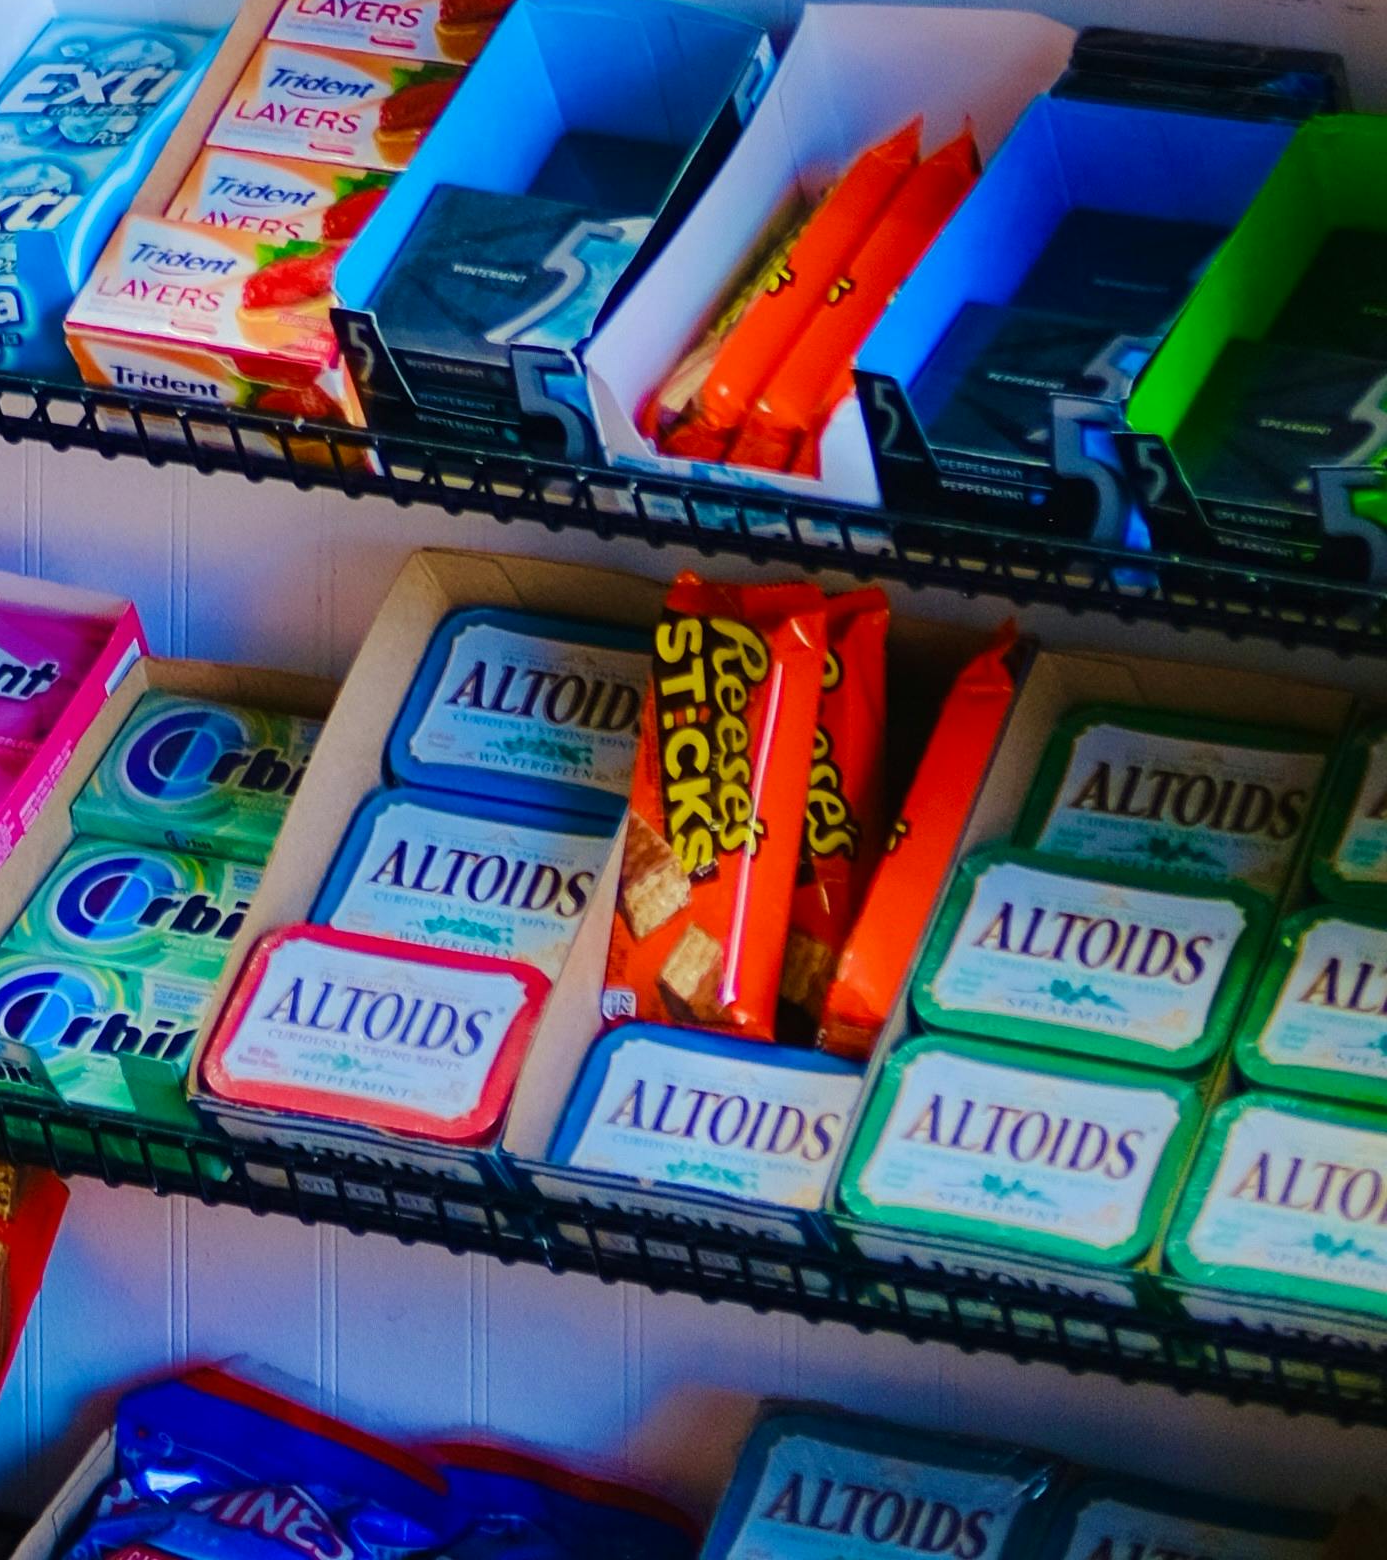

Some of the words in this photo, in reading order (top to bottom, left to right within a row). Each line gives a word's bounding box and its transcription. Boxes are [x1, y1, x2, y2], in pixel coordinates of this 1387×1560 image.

[234, 99, 362, 136] LAYERS
[452, 260, 528, 287] WINTERMINT
[96, 278, 225, 315] LAYERS
[987, 373, 1066, 392] PEPPERMINT
[940, 479, 1027, 503] PEPPERMINT
[653, 616, 717, 875] STICKS
[972, 900, 1212, 987] ALTOIDS
[270, 976, 495, 1059] ALTOIDS
[1004, 996, 1135, 1029] SPEARMINT
[267, 1026, 347, 1052] CURIOUSLY
[350, 1040, 416, 1064] STRONG
[289, 1068, 412, 1100] PEPPERMINT
[608, 1076, 840, 1164] ALTOIDS
[901, 1092, 1145, 1180] ALTOIDS
[935, 1189, 1065, 1223] SPEARMINT
